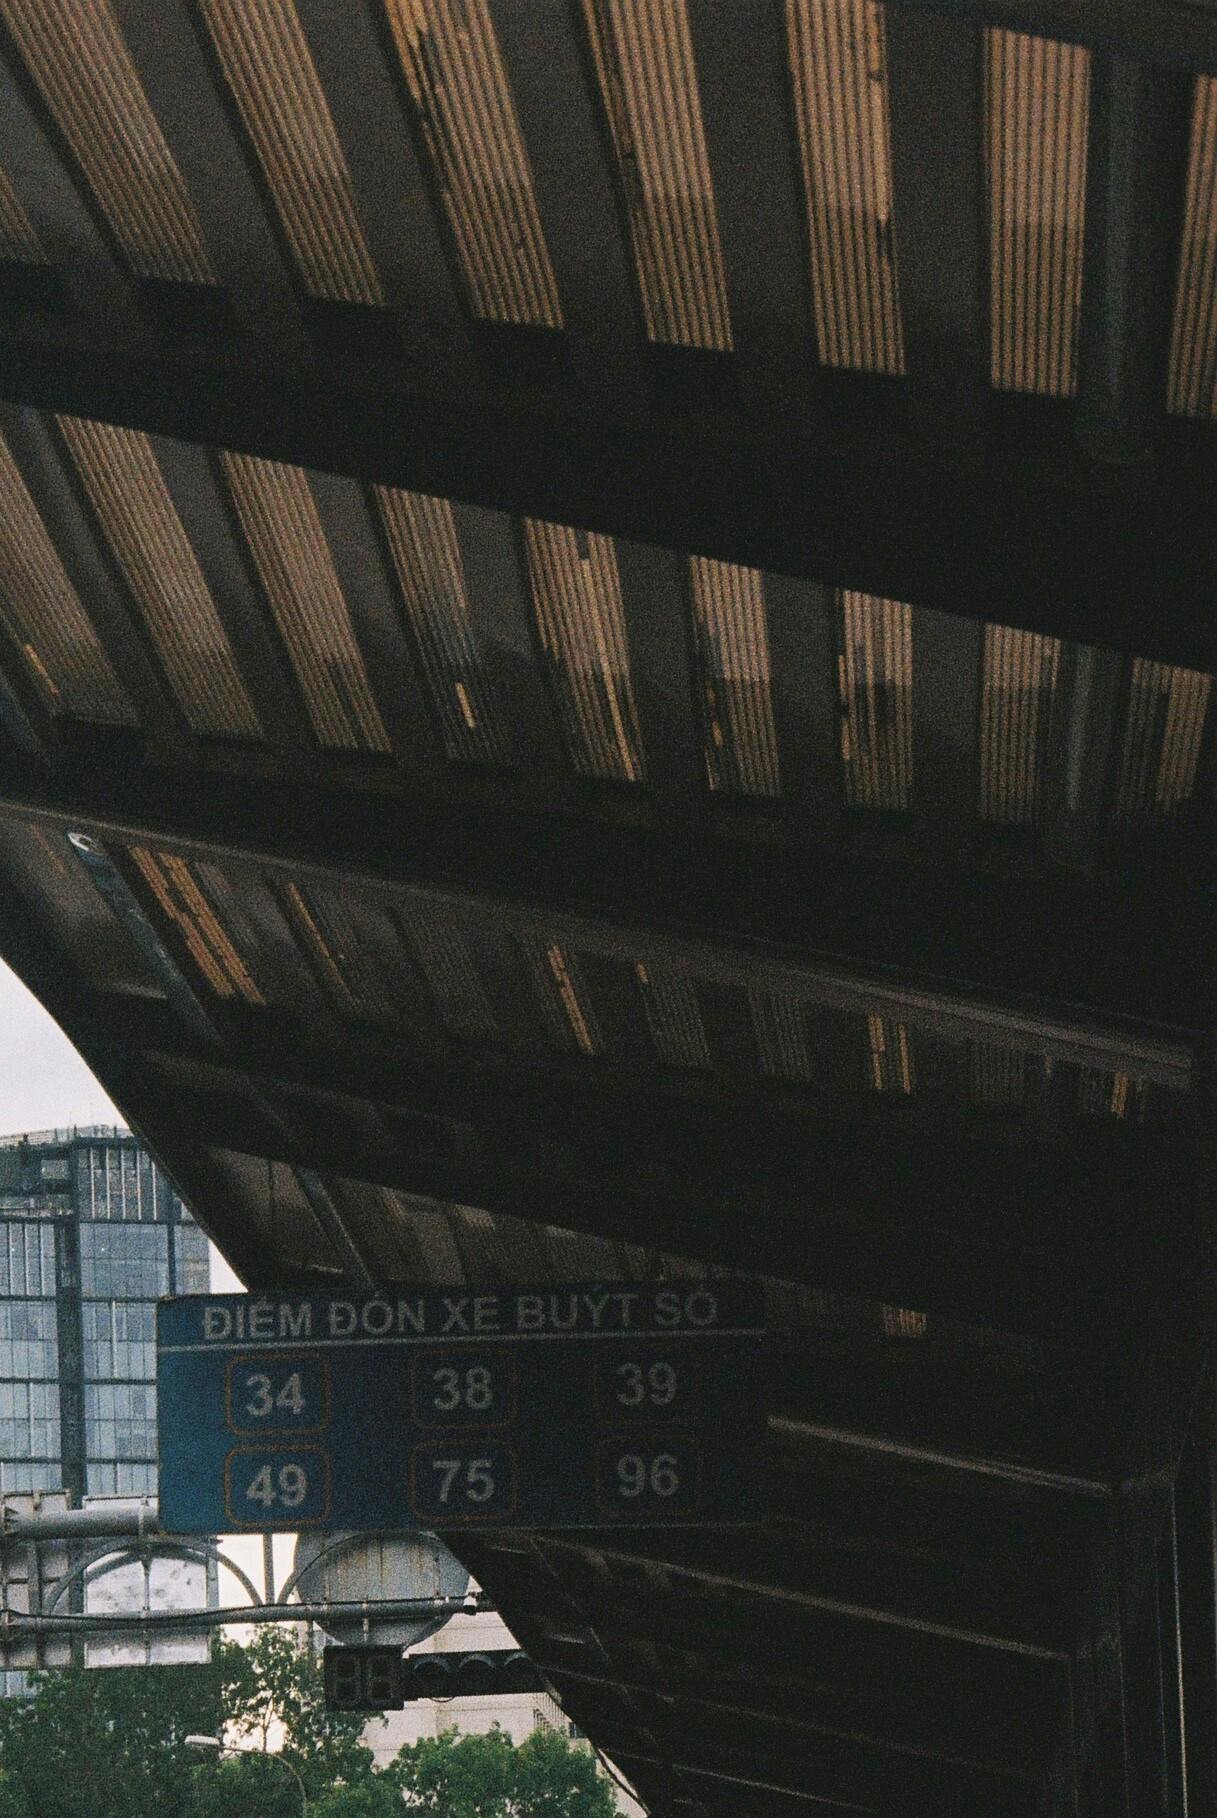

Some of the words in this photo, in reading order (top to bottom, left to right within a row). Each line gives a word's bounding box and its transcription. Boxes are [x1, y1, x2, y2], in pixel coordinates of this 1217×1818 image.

[441, 1295, 500, 1331] XE
[245, 1372, 305, 1416] 34
[431, 1367, 495, 1410] 38
[616, 1362, 678, 1405] 39
[245, 1463, 307, 1507] 49
[431, 1459, 496, 1503] 75
[616, 1453, 680, 1497] 96
